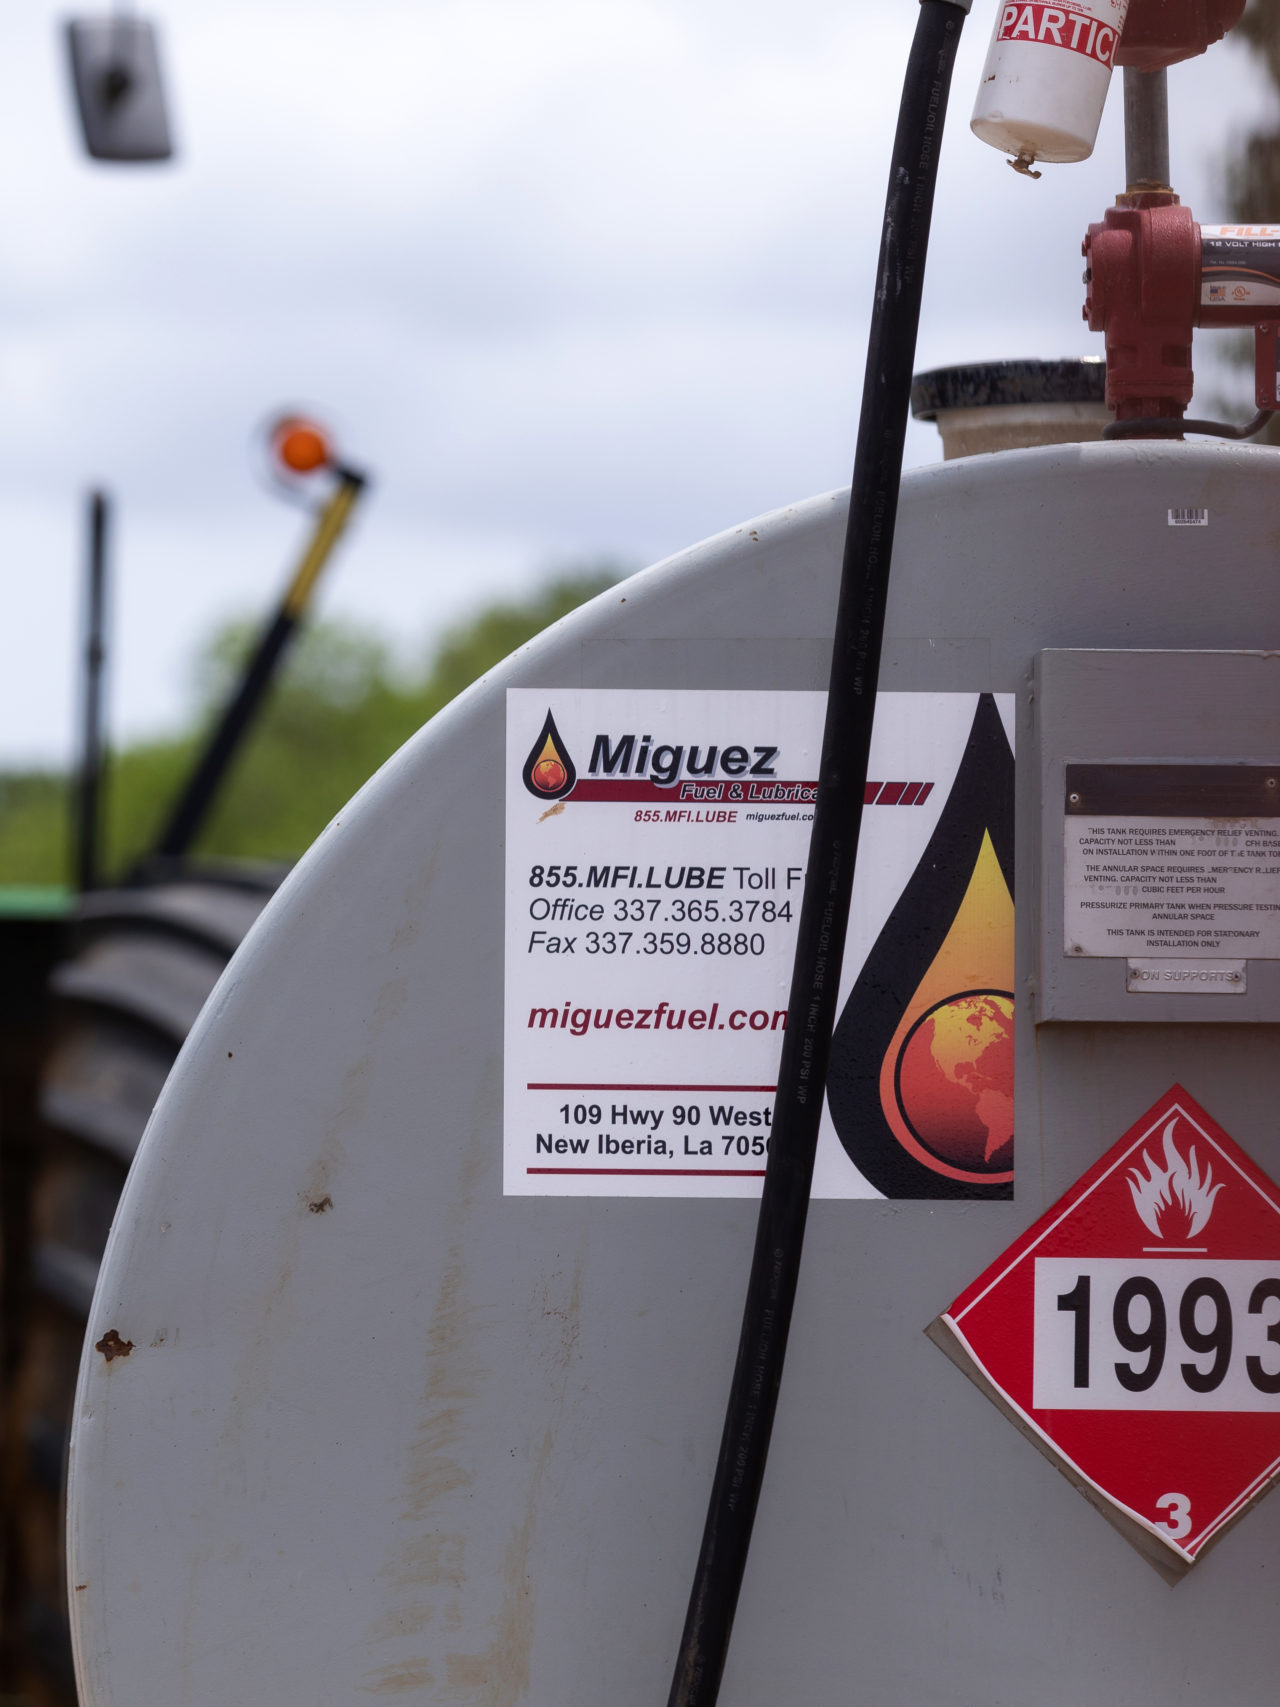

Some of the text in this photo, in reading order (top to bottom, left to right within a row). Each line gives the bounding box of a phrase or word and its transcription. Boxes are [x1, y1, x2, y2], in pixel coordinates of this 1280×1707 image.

[588, 734, 779, 787] Miguez
[680, 783, 722, 801] Fuel
[728, 784, 743, 801] &
[634, 810, 738, 823] 855.MFI.LUBE
[1107, 828, 1126, 836] TANK
[1129, 828, 1166, 836] REQUIRES
[1169, 829, 1215, 837] EMERGENCY
[1135, 838, 1153, 846] LESS
[528, 866, 807, 890] 855.MFI.LUBE Toll F
[1103, 865, 1139, 873] ANNULAR
[1084, 875, 1118, 883] VENTING.
[1197, 876, 1217, 884] THAN
[1142, 886, 1165, 894] CUBIC
[1167, 886, 1184, 894] FEET
[1187, 886, 1201, 894] PER
[529, 899, 793, 923] Office 337.365.3784
[1130, 902, 1164, 910] PRIMARY
[1188, 903, 1211, 911] WHEN
[1213, 903, 1253, 911] PRESSURE
[1125, 929, 1145, 937] TANK
[1147, 929, 1155, 937] IS
[1157, 929, 1195, 937] INTENDED
[528, 931, 765, 956] Fax 337.359.8880
[1202, 940, 1220, 948] ONLY
[1164, 971, 1233, 981] SUPPORTS
[807, 1003, 819, 1032] INCH
[799, 1059, 811, 1080] PSI
[796, 1084, 807, 1104] WP
[560, 1104, 772, 1131] 109 Hwy 90 West
[536, 1133, 588, 1156] New
[598, 1134, 674, 1159] Iberia,
[684, 1135, 713, 1156] La
[1057, 1275, 1280, 1393] 1993
[1154, 1492, 1192, 1540] 3
